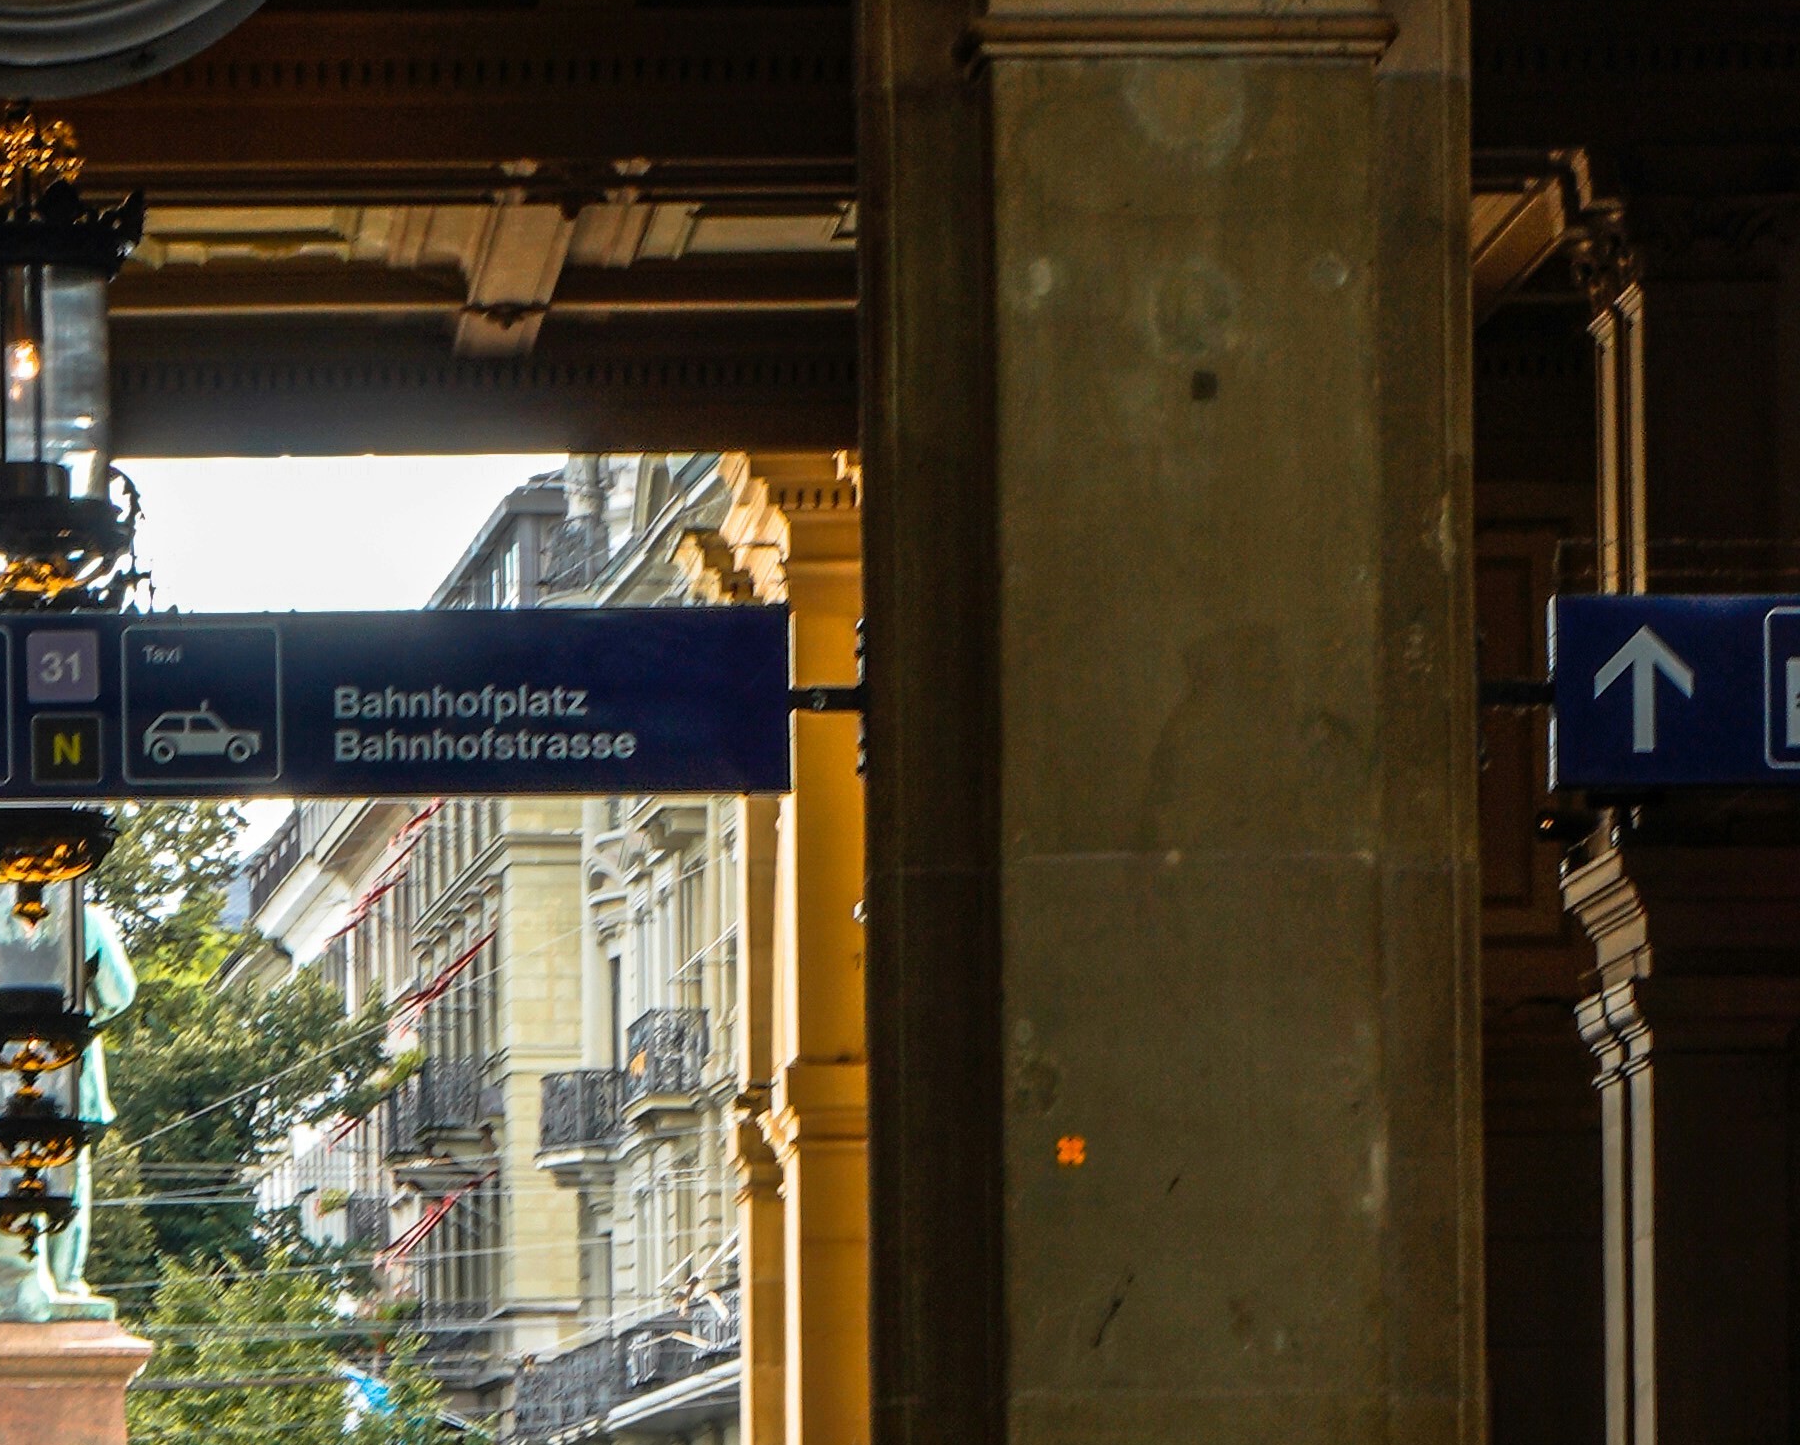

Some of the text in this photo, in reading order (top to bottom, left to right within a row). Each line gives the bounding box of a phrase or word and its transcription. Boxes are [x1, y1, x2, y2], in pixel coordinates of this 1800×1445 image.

[40, 649, 82, 684] 31
[142, 644, 184, 665] Taxi
[334, 684, 590, 724] Bahnhofplatz
[52, 731, 82, 766] N
[334, 726, 637, 763] Bahnhofstrasse
